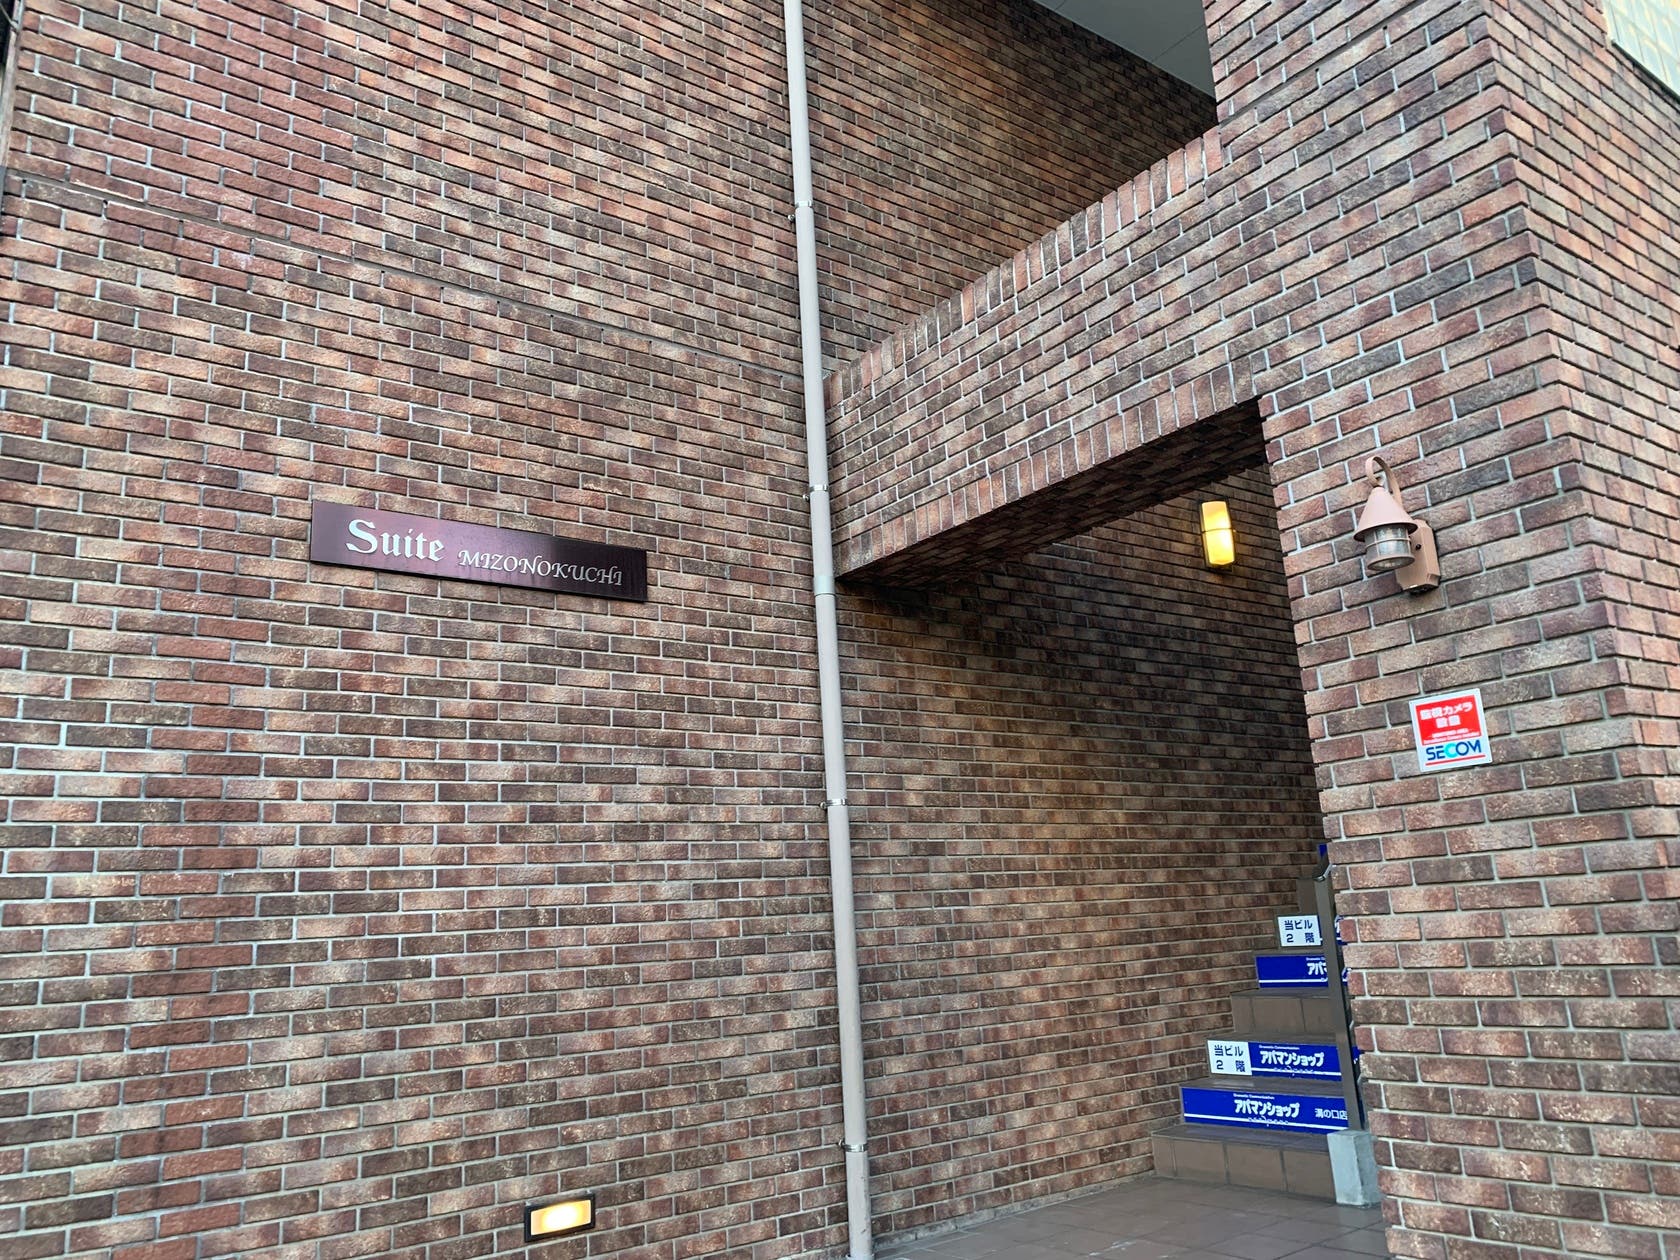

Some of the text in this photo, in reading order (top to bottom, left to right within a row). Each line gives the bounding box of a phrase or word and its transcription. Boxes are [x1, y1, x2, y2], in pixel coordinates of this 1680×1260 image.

[346, 519, 623, 586] Suite MIZONOKUCHI
[1426, 739, 1482, 761] SECOM
[1284, 919, 1313, 930] 当ビル
[1214, 1045, 1244, 1057] 当ビル
[1260, 1050, 1325, 1067] アパマンショップ
[1233, 1099, 1301, 1118] アパマンショップ
